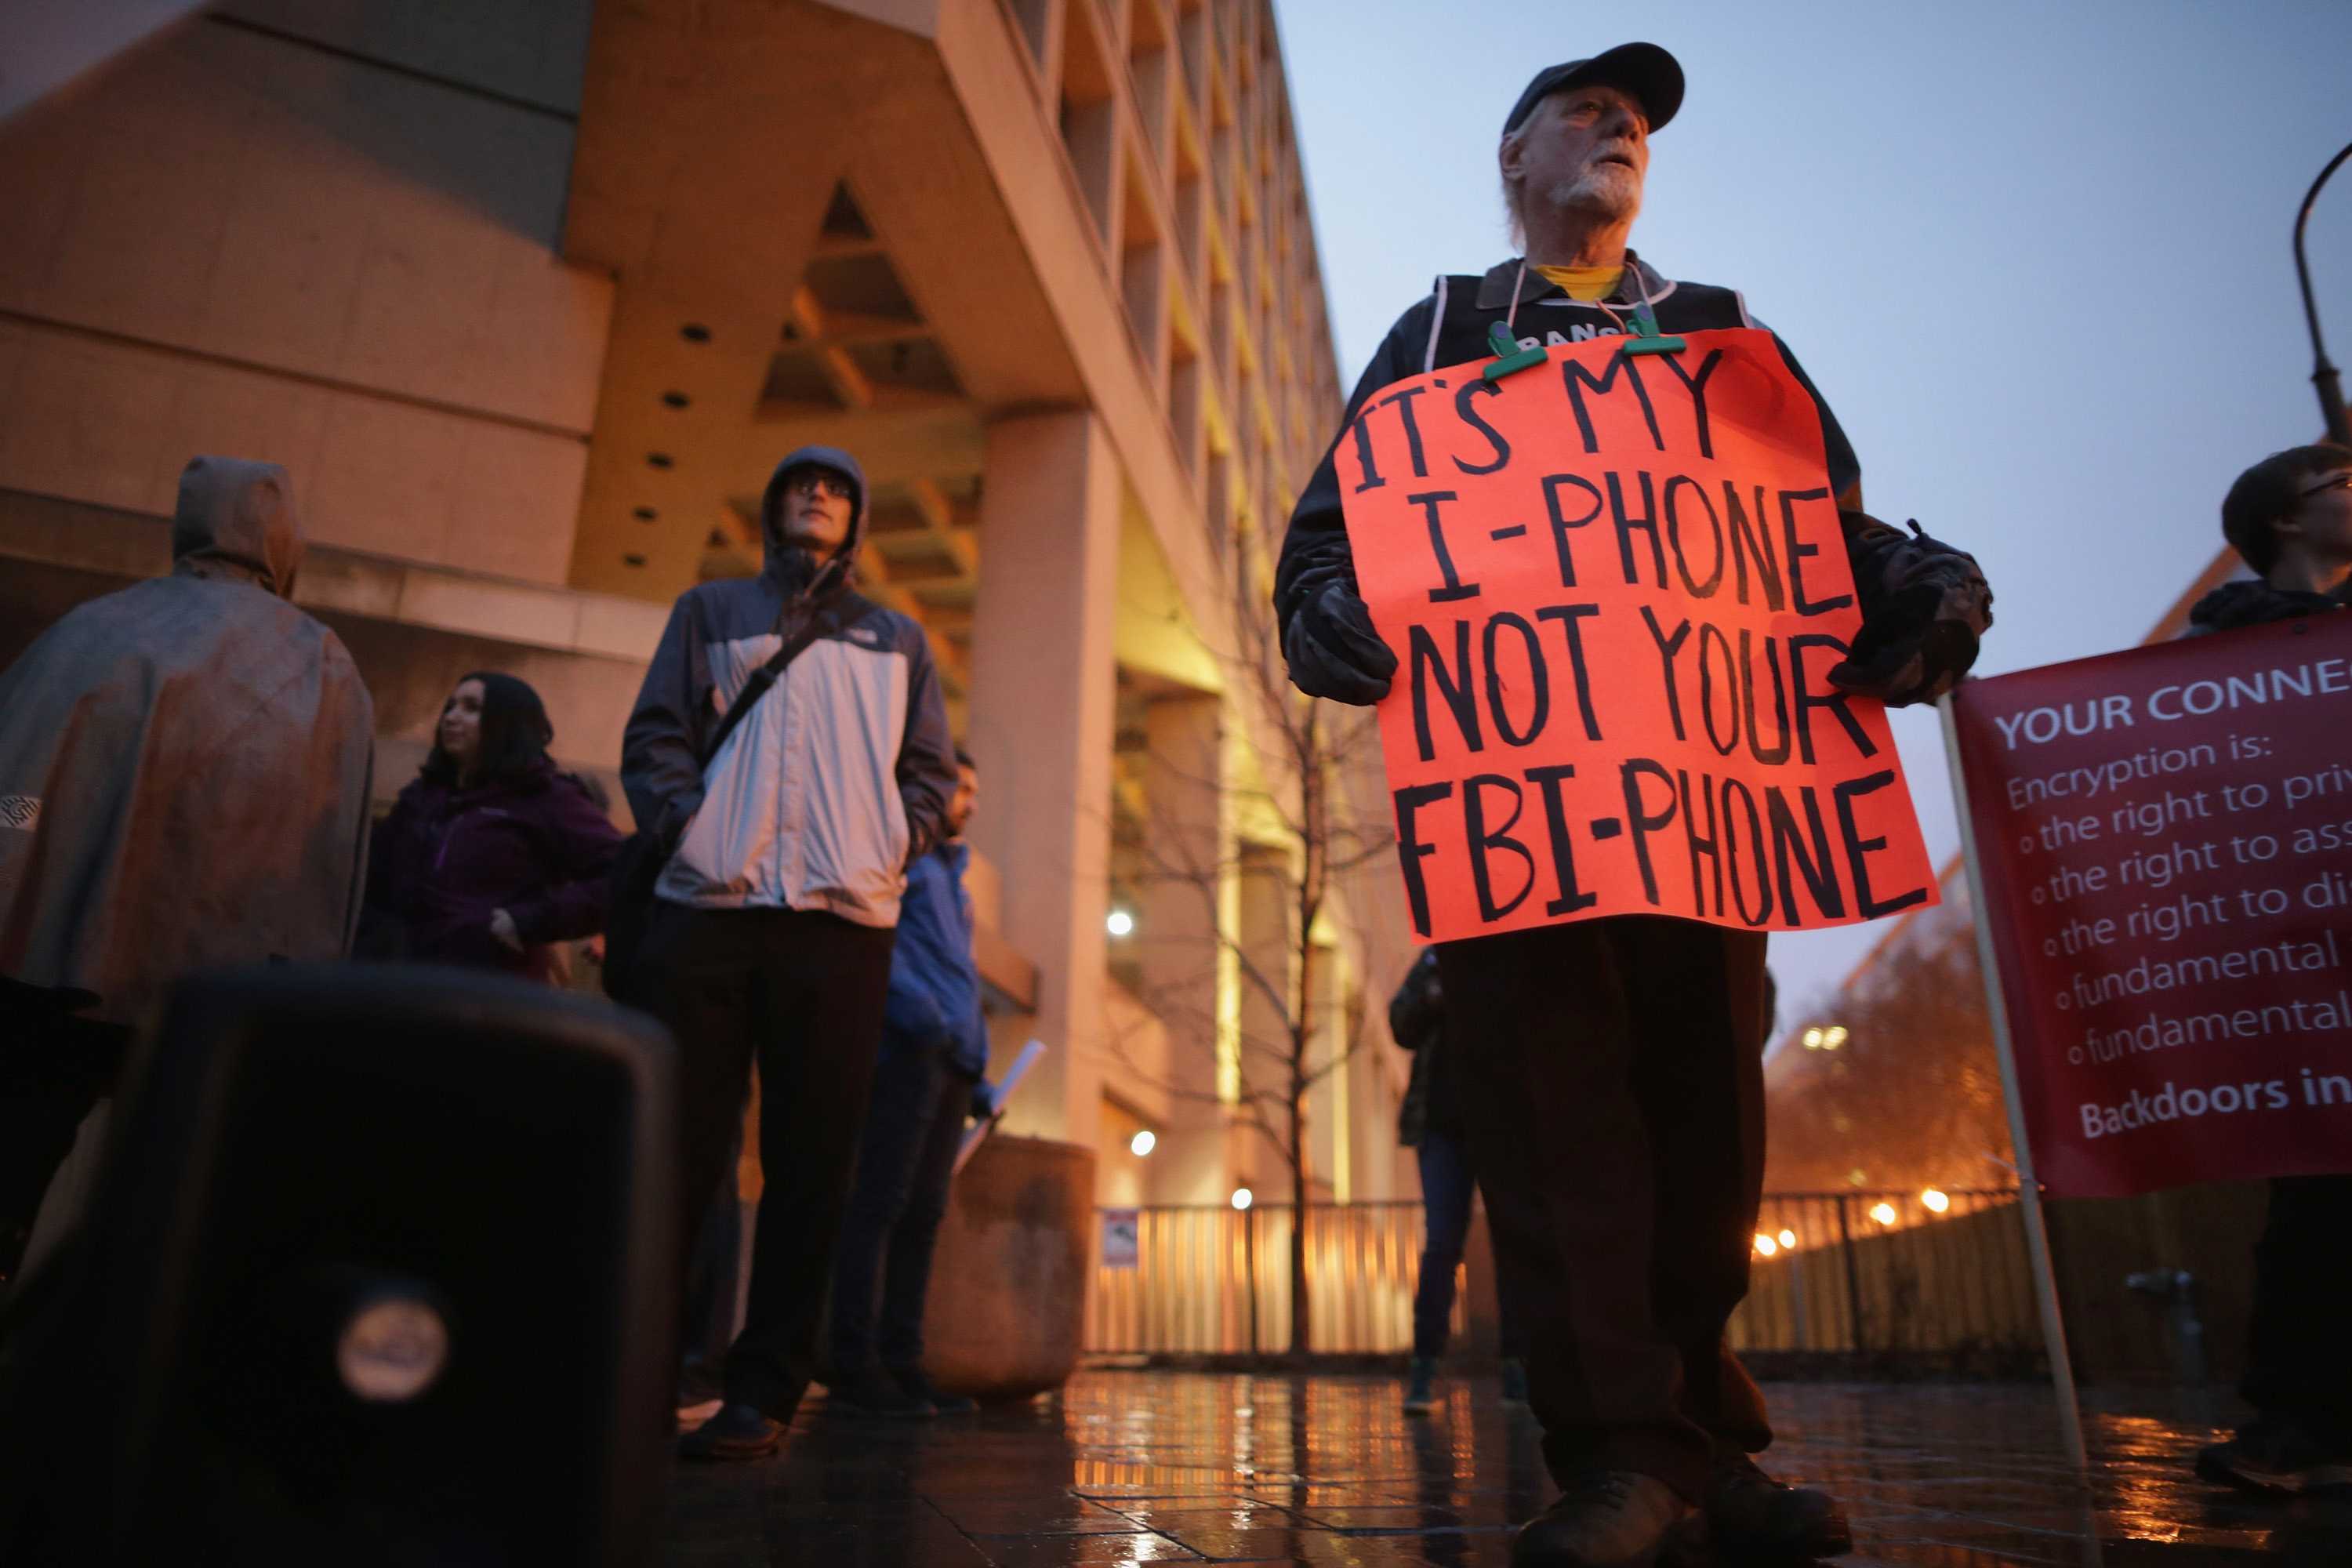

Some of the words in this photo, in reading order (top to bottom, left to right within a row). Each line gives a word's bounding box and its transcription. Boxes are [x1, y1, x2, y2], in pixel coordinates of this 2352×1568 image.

[1352, 378, 1512, 495] IT'S
[1562, 348, 1724, 459] MY
[1409, 603, 1602, 762] NOT
[1639, 604, 1878, 766] YOUR
[1995, 694, 2133, 750] YOUR
[2148, 659, 2352, 721] CONNE
[2008, 743, 2216, 810] Encryption
[2229, 734, 2273, 760] is:
[1394, 757, 1927, 938] FBI-PHONE
[2039, 815, 2101, 851] the
[2113, 790, 2212, 836] right
[2221, 784, 2269, 811] to
[2048, 866, 2109, 903] the
[2120, 842, 2220, 888] right
[2230, 836, 2278, 863] to
[2058, 917, 2117, 956] the
[2127, 894, 2230, 940] right
[2238, 889, 2288, 917] to
[2303, 872, 2352, 908] di
[2074, 928, 2341, 1007] fundamental
[2086, 990, 2352, 1065] fundamental
[2081, 1076, 2289, 1139] Backdoors
